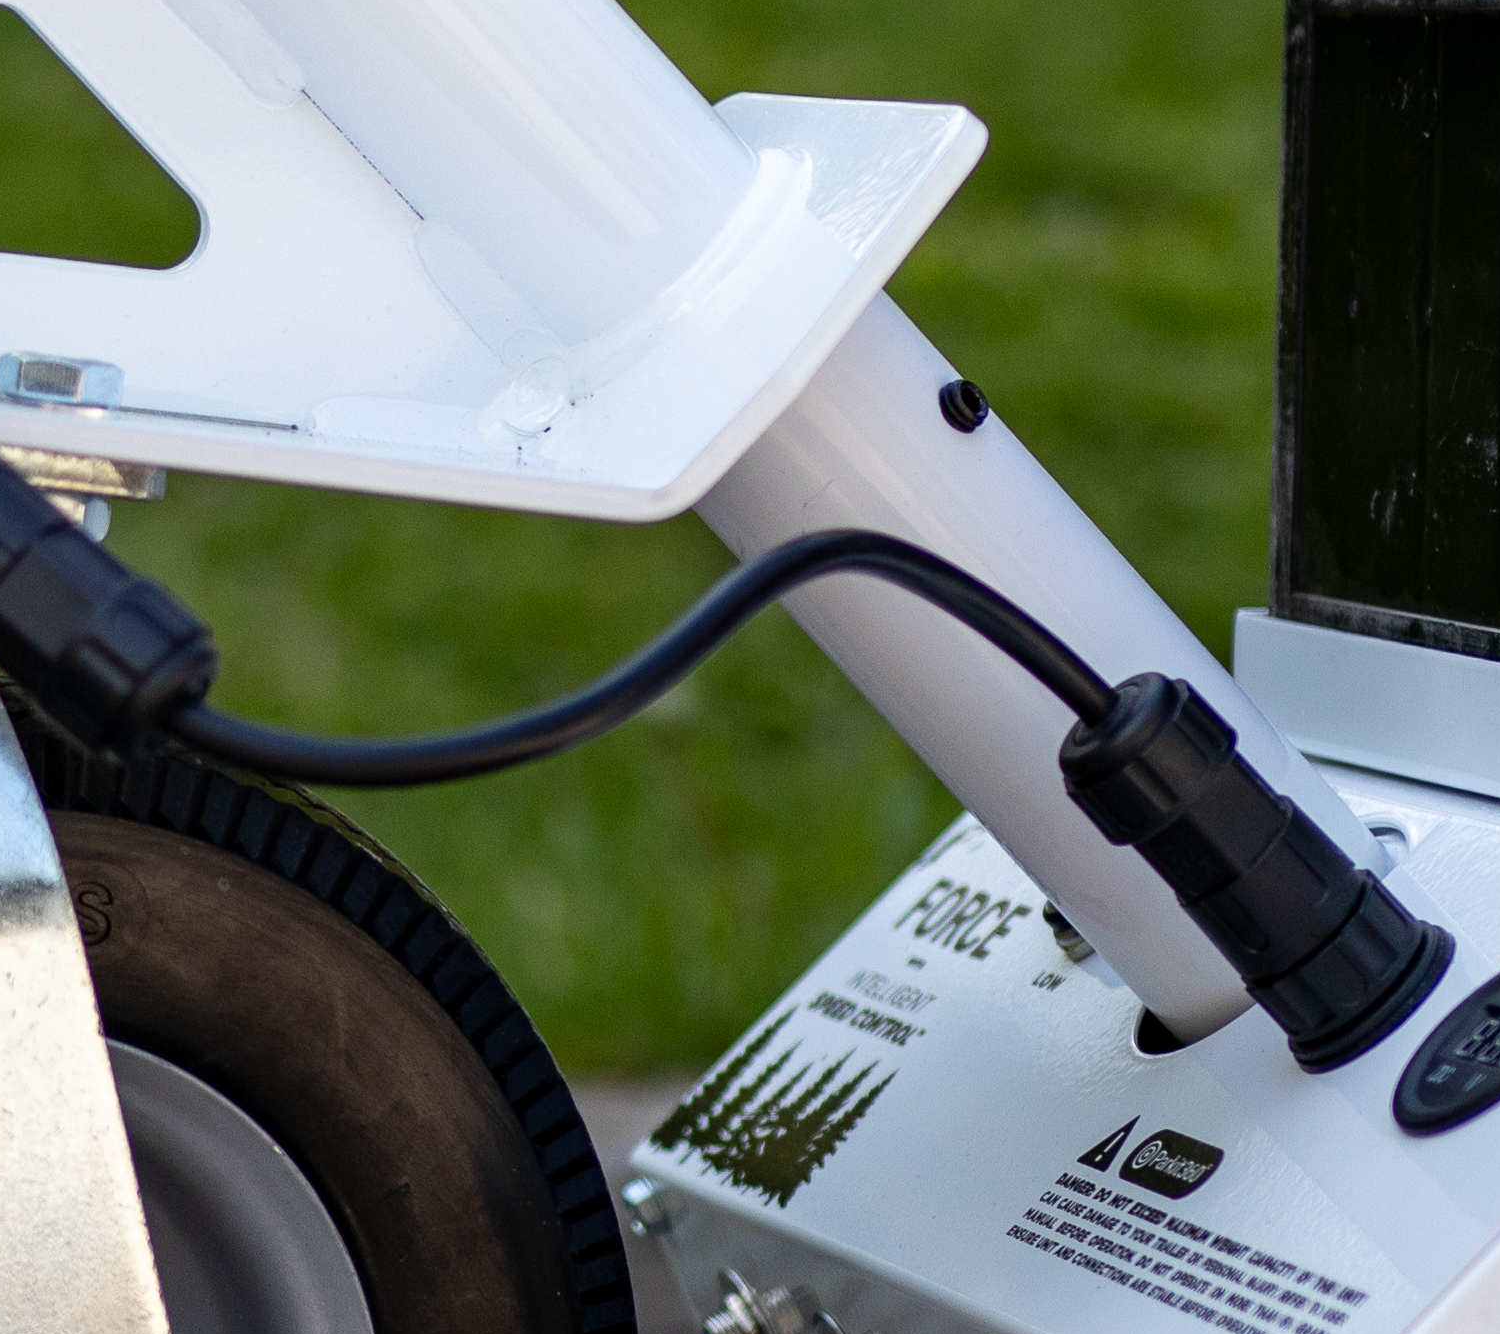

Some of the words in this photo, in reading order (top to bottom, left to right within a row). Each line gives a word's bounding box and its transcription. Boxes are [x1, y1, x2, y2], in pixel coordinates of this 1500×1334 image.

[893, 878, 1033, 960] FORCE
[846, 970, 938, 1014] INTELLIGENT
[1031, 971, 1067, 992] LOW
[807, 990, 858, 1022] SPEED
[1038, 1191, 1058, 1206] CAN
[1056, 1198, 1084, 1217] CAUSE
[1116, 1222, 1130, 1235] TO
[1092, 1188, 1110, 1203] DO
[1108, 1193, 1131, 1211] NOT
[1022, 1208, 1056, 1229] MANUAL
[1055, 1222, 1088, 1242] BEFORE
[1007, 1225, 1038, 1245] ENSURE
[1035, 1237, 1056, 1253] UNIT
[1054, 1245, 1073, 1260] AND
